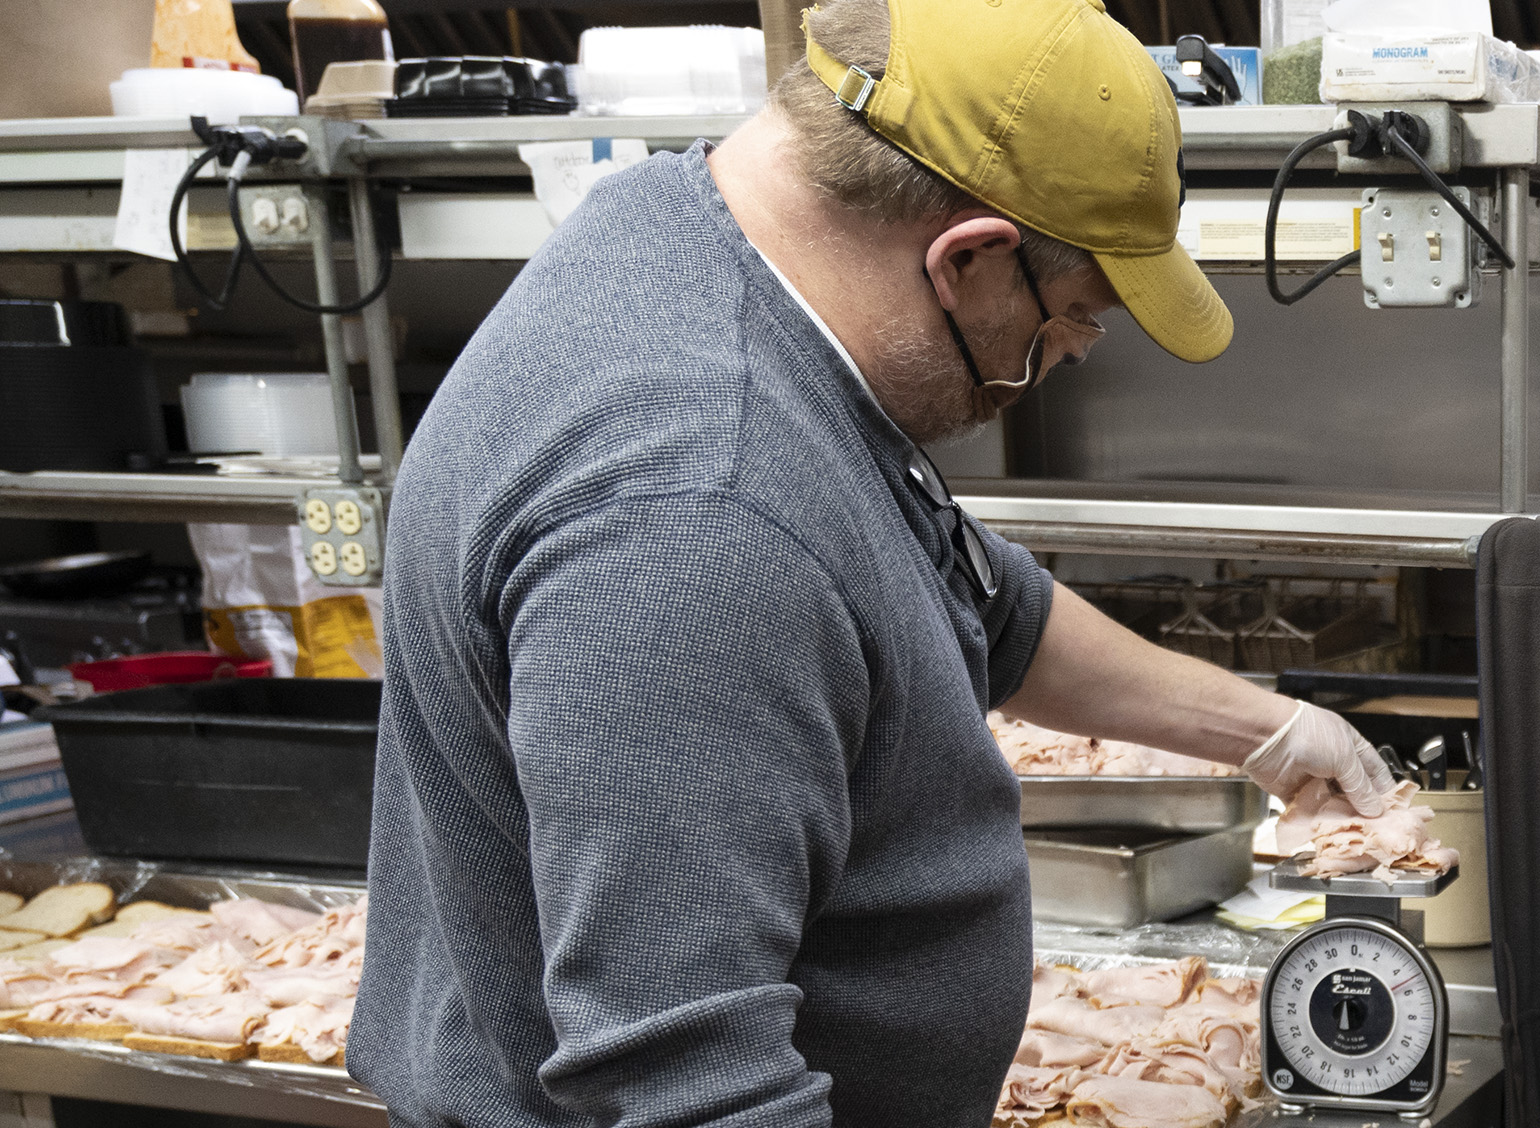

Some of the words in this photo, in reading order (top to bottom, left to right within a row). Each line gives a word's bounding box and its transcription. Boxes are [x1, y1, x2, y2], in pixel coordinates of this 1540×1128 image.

[1373, 47, 1428, 59] MONOGRAM
[1325, 948, 1338, 960] 30
[1350, 944, 1358, 956] 0
[1372, 952, 1381, 962] 2
[1304, 959, 1318, 973] 28
[1392, 968, 1401, 976] 4
[1292, 978, 1304, 991] 26
[1405, 989, 1413, 997] 6
[1287, 1002, 1297, 1015] 24
[1290, 1025, 1302, 1038] 22
[1400, 1035, 1412, 1048] 10
[1301, 1045, 1314, 1058] 20
[1387, 1053, 1400, 1066] 12
[1320, 1062, 1332, 1073] 18
[1344, 1069, 1355, 1078] 16
[1366, 1065, 1379, 1076] 14
[1276, 1074, 1291, 1085] NSF
